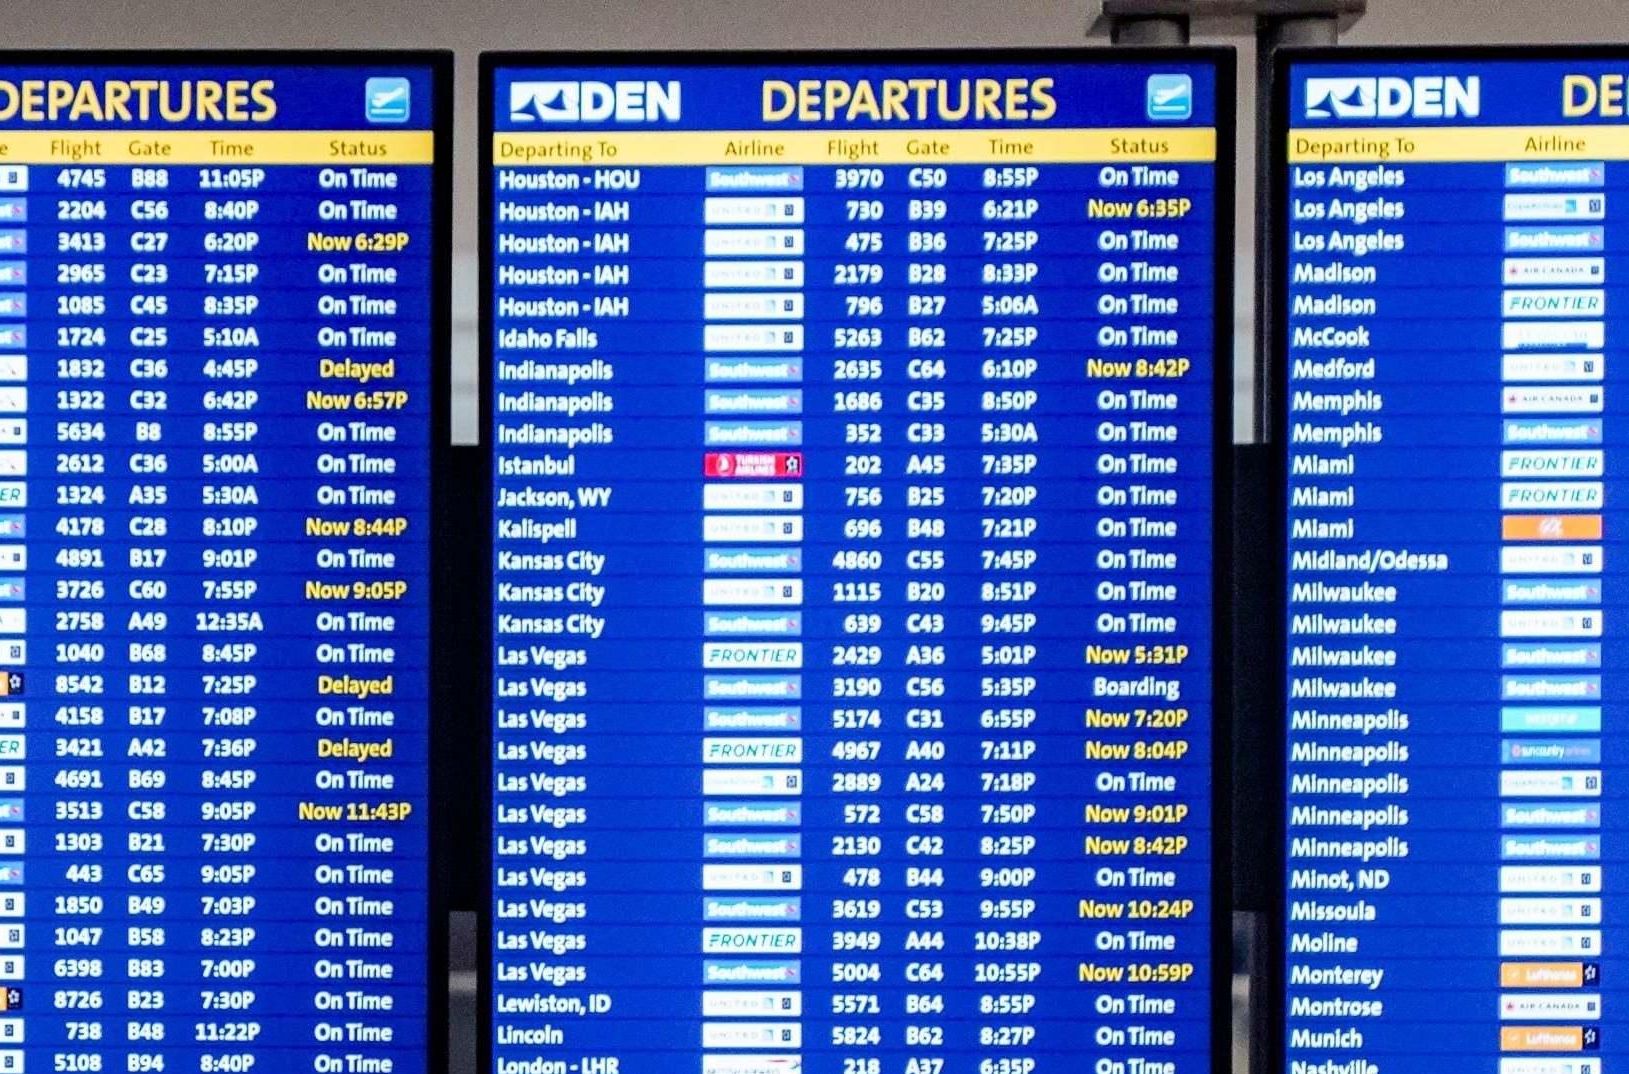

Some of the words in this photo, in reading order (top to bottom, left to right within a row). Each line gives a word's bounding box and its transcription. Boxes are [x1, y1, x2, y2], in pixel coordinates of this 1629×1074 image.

[582, 81, 680, 120] DEN
[763, 78, 1056, 121] DEPARTURES
[1378, 77, 1479, 116] DEN
[1563, 75, 1629, 116] DE
[51, 140, 100, 158] Flight
[129, 141, 171, 155] Gate
[210, 141, 253, 155] Time
[330, 140, 387, 156] Status
[501, 142, 592, 157] Departing
[599, 142, 617, 156] To
[725, 140, 784, 156] Airline
[828, 139, 878, 157] Flight
[907, 140, 949, 155] Gate
[990, 139, 1033, 154] Time
[1111, 138, 1168, 154] Status
[1297, 138, 1389, 155] Departing
[1396, 138, 1414, 153] To
[1525, 136, 1585, 151] Airline
[1295, 167, 1325, 186] Los
[1329, 165, 1404, 190] Angeles
[1510, 167, 1589, 184] Southwest
[58, 201, 106, 219] 2204
[131, 200, 168, 219] C56
[205, 200, 258, 219] 8:40P
[319, 201, 347, 219] On
[350, 200, 397, 219] Time
[1294, 295, 1375, 314] Madison
[1510, 296, 1599, 311] FRONTIER
[1292, 709, 1408, 734] Minneapolis
[56, 739, 103, 756] 3421
[128, 738, 165, 756] A42
[203, 739, 255, 756] 7:36P
[318, 738, 392, 762] Delayed
[499, 742, 528, 759] Las
[531, 741, 586, 764] Vegas
[709, 742, 797, 759] FRONTIER
[832, 742, 880, 759] 4967
[906, 741, 944, 759] A40
[982, 741, 1035, 759] 7:11P
[1086, 741, 1130, 759] Now
[1134, 741, 1188, 759] 8:04P
